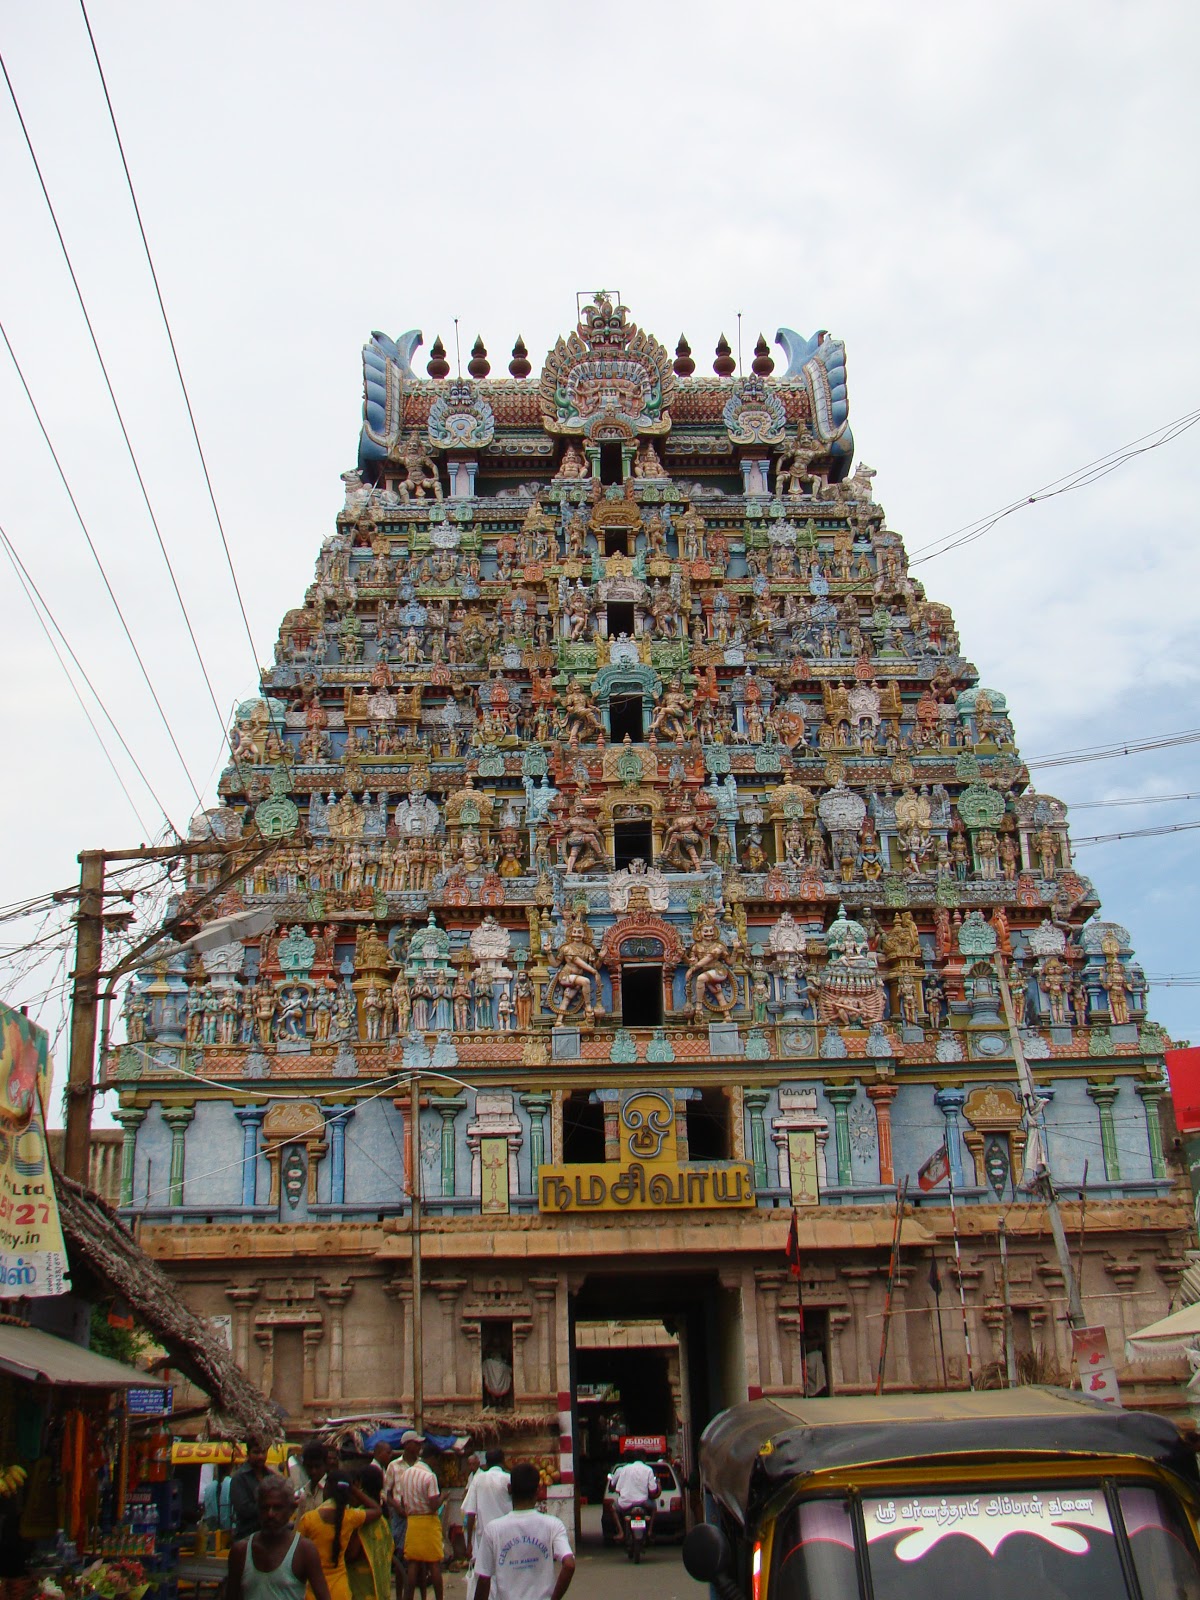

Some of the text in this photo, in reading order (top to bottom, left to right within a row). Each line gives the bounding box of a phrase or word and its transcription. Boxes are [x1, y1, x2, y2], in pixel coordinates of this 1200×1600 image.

[176, 1444, 246, 1458] BSN
[876, 1502, 897, 1524] ஸ்ரீ
[986, 1495, 1043, 1518] அம்மாள்
[1048, 1497, 1094, 1516] துணை
[498, 1535, 549, 1566] GENIUS TAILORS
